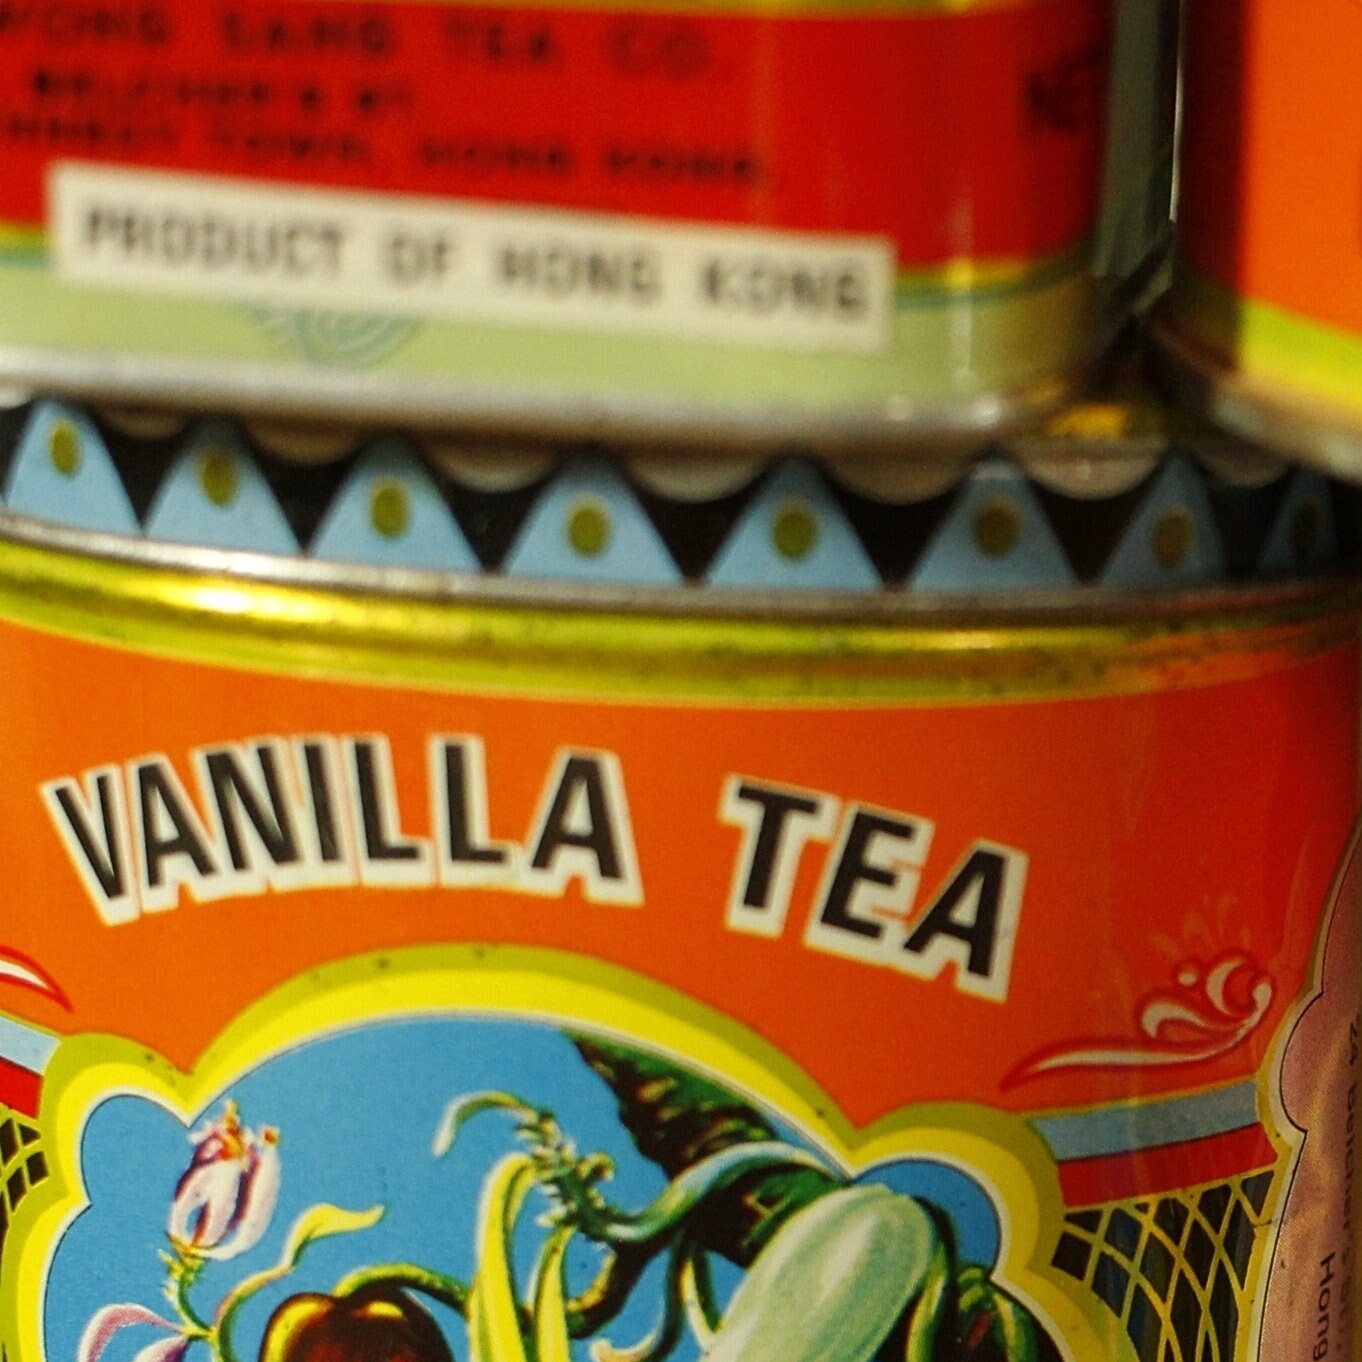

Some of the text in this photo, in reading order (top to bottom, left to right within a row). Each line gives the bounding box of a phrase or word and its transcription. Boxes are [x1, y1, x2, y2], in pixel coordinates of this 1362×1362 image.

[85, 204, 870, 326] PRODUCT OF HONG KONG
[40, 732, 1030, 1003] VANILLA TEA
[1312, 1251, 1337, 1362] Hong
